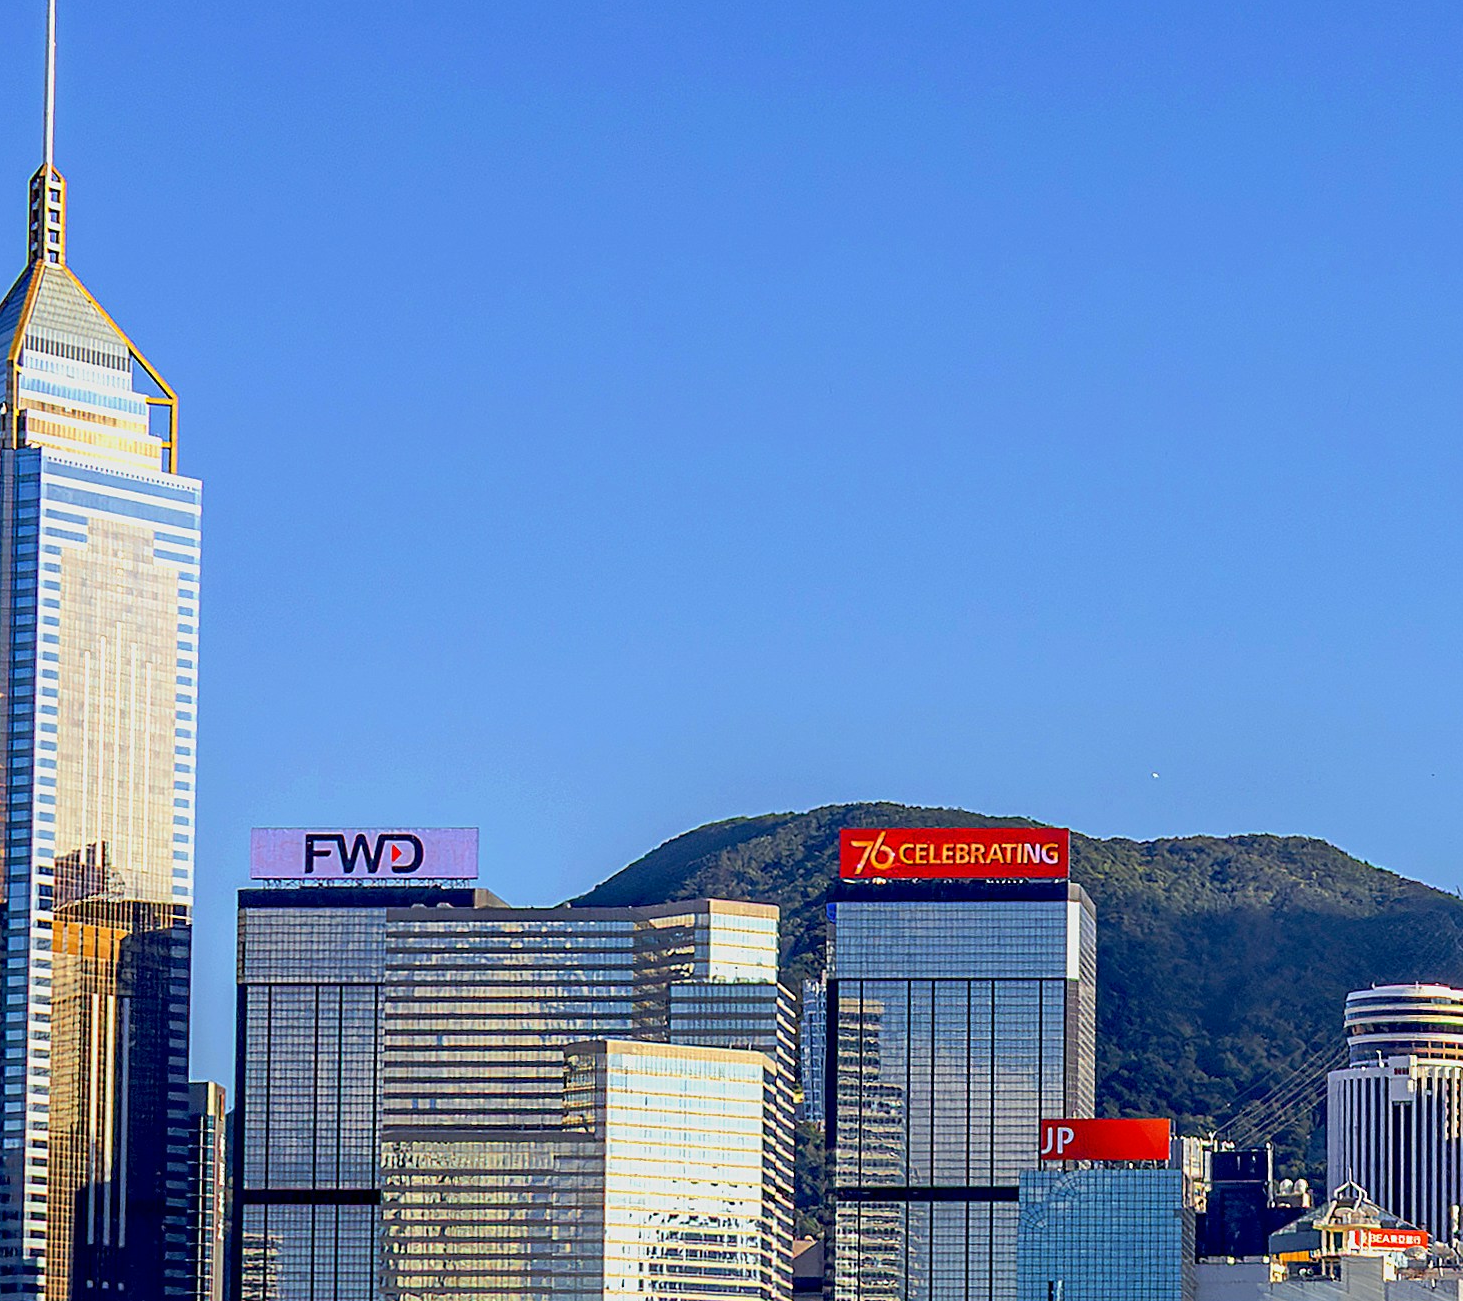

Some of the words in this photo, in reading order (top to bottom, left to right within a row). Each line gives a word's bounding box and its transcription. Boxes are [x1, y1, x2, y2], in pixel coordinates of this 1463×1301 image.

[305, 834, 423, 873] FWD
[851, 831, 895, 875] 76
[899, 843, 1059, 865] CELEBRATING
